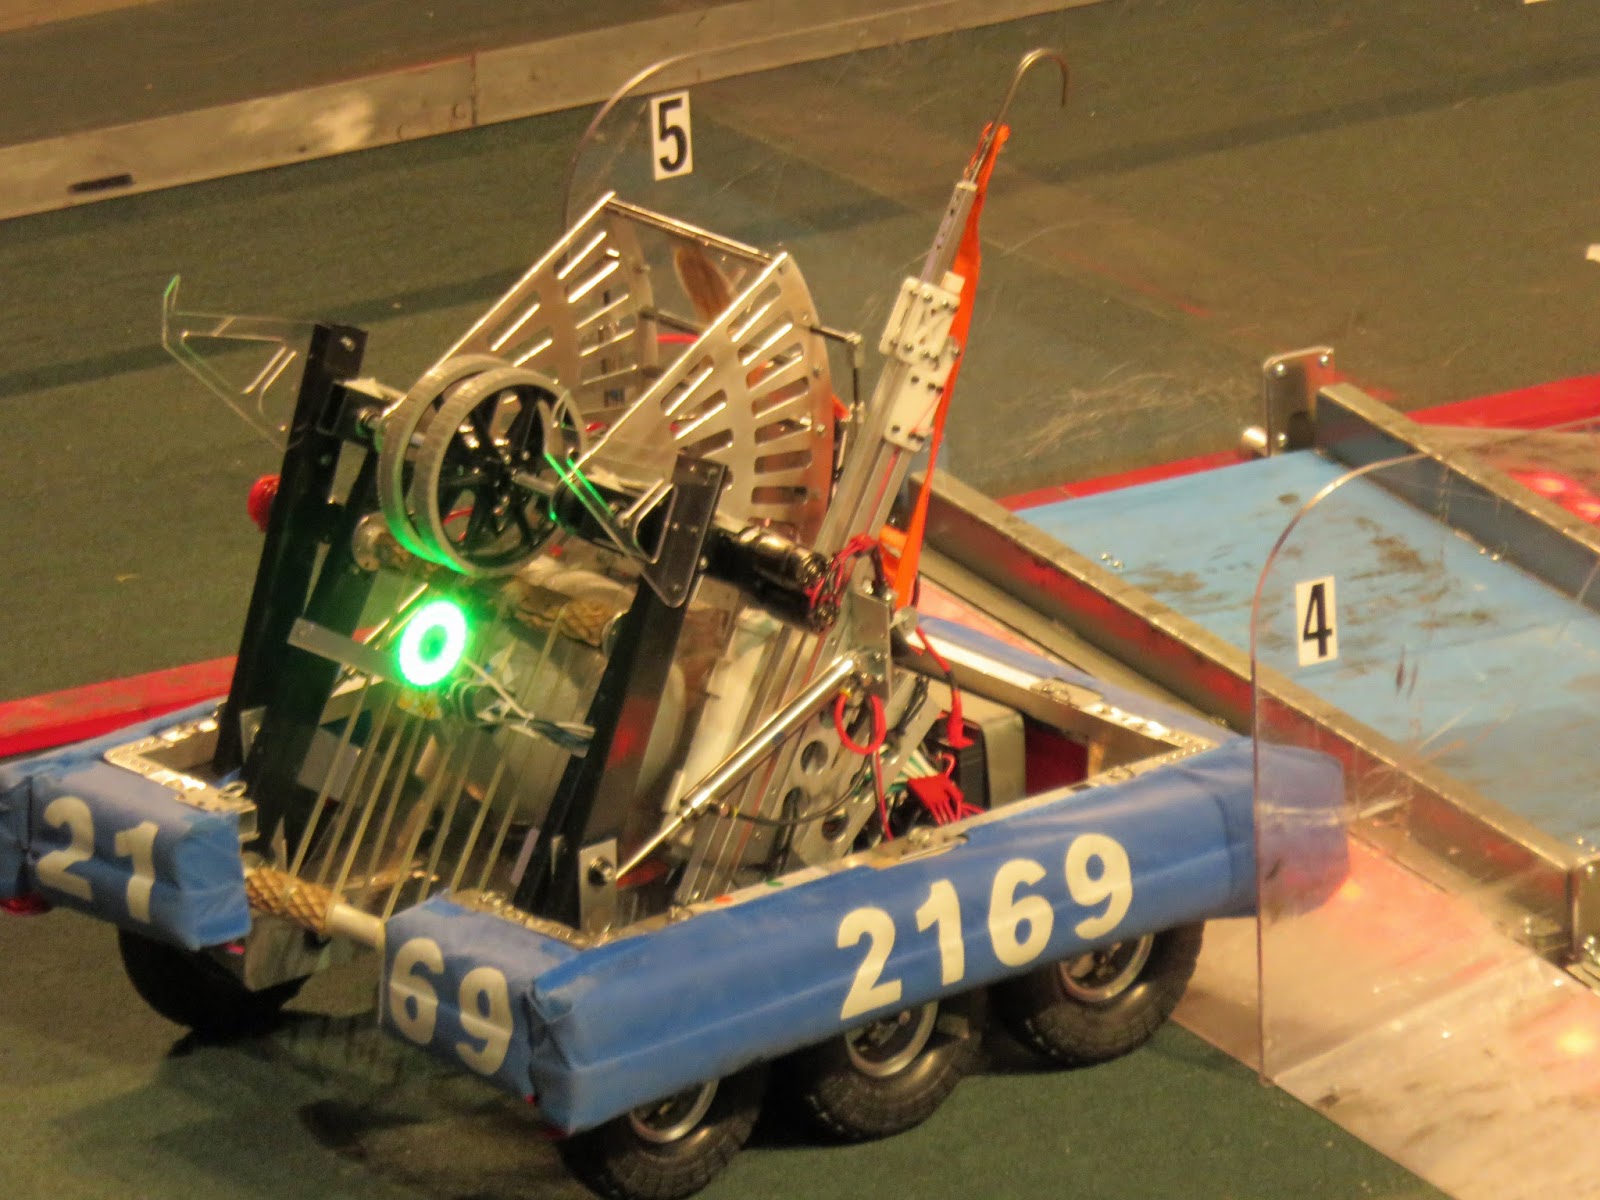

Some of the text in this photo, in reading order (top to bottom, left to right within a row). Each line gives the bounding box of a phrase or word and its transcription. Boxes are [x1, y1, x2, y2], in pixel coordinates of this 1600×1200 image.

[658, 98, 688, 172] 5
[1303, 583, 1333, 657] 4
[36, 796, 160, 922] 21
[836, 834, 1132, 1020] 2169
[390, 937, 513, 1075] 69
